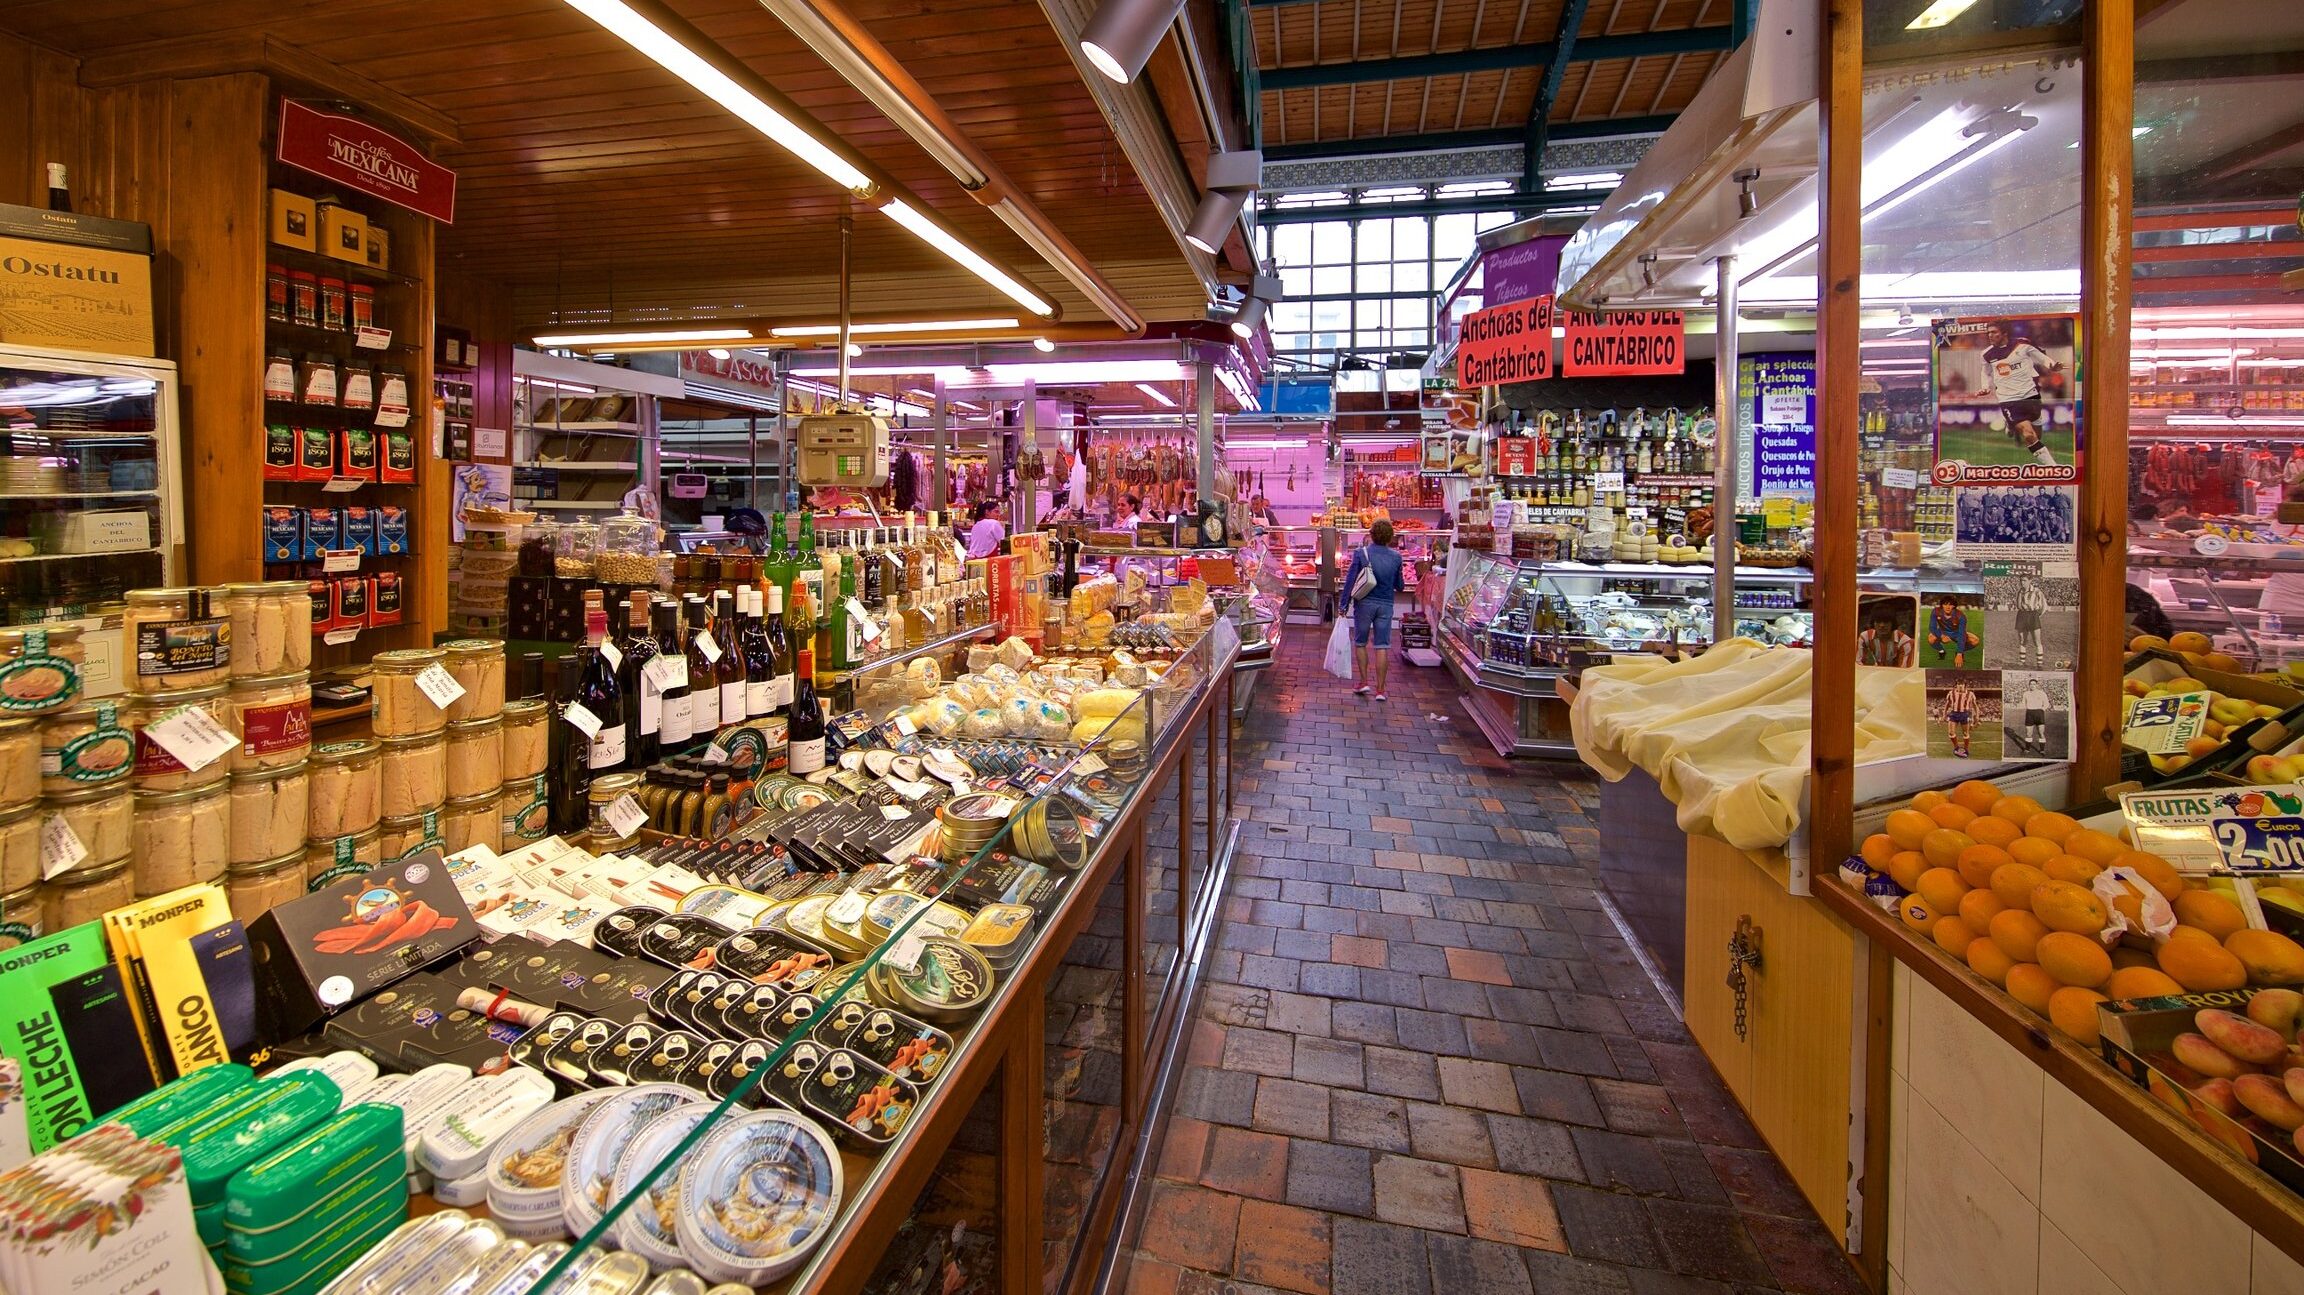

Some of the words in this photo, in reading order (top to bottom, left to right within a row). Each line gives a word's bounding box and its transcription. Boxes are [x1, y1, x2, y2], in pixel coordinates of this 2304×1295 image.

[333, 142, 419, 190] MEXICANA
[356, 173, 375, 186] Desde
[42, 213, 77, 225] Ostatu
[1488, 246, 1538, 273] Productos
[2, 256, 120, 285] Ostatu
[1460, 308, 1524, 345] Anchoas
[1528, 298, 1552, 331] del
[1573, 329, 1676, 366] CANTÁBRICO
[1464, 343, 1547, 386] Cantábrico
[1739, 361, 1771, 372] Gran
[1424, 379, 1438, 388] LA
[1739, 374, 1755, 385] de
[1757, 372, 1806, 384] Anchoas
[1739, 386, 1759, 398] del
[1761, 437, 1798, 449] Quesadas
[1761, 451, 1797, 462] Quesucos
[1797, 451, 1806, 461] de
[1761, 466, 1785, 477] Orujo
[1786, 465, 1795, 476] de
[1936, 466, 1958, 478] 03
[1966, 466, 2019, 479] Marcos
[2021, 465, 2073, 479] Alonso
[1761, 479, 1788, 489] Bonito
[1788, 479, 1800, 489] del
[1528, 508, 1543, 516] ELES
[1543, 507, 1552, 516] DE
[1552, 507, 1586, 517] CANTABRIA
[100, 520, 134, 529] ANCHOA
[1984, 563, 2037, 571] Racing
[991, 561, 1000, 603] CORBATAS
[170, 644, 214, 654] BONITO
[2133, 798, 2212, 818] FRUTAS
[138, 898, 206, 930] MONPER
[513, 901, 550, 923] CODESA
[565, 909, 600, 931] CODESA
[366, 963, 395, 983] SERIE
[395, 941, 443, 968] LIMITADA
[2184, 987, 2265, 1007] ROYA
[17, 1010, 75, 1102] LECHE
[119, 1260, 171, 1295] CACAO
